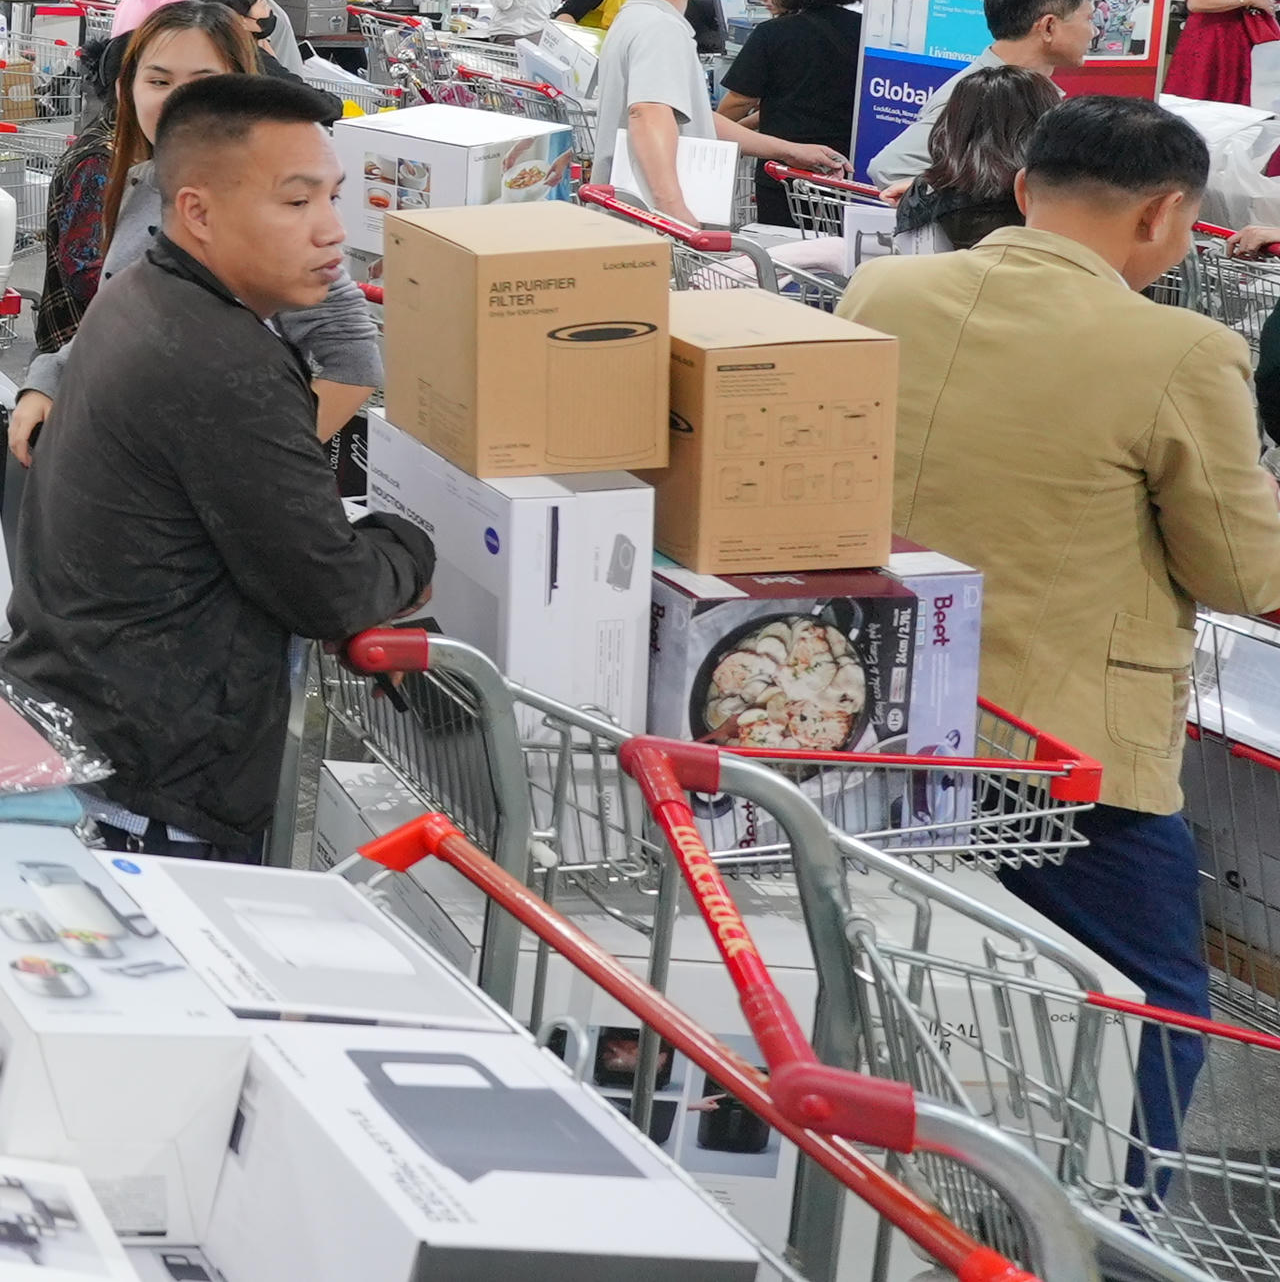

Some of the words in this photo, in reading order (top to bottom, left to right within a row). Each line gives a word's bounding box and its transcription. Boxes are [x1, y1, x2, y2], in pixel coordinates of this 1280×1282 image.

[928, 45, 978, 62] Livingwar
[473, 151, 501, 163] LocknLock
[603, 258, 657, 271] LocknLock
[489, 280, 512, 294] AIR
[516, 277, 576, 292] PURIFIER
[489, 294, 535, 308] FILTER
[370, 464, 401, 491] LocknLock
[371, 482, 406, 515] INDUCTION
[405, 509, 436, 534] COOKER
[671, 823, 756, 958] LOCK&LOCK
